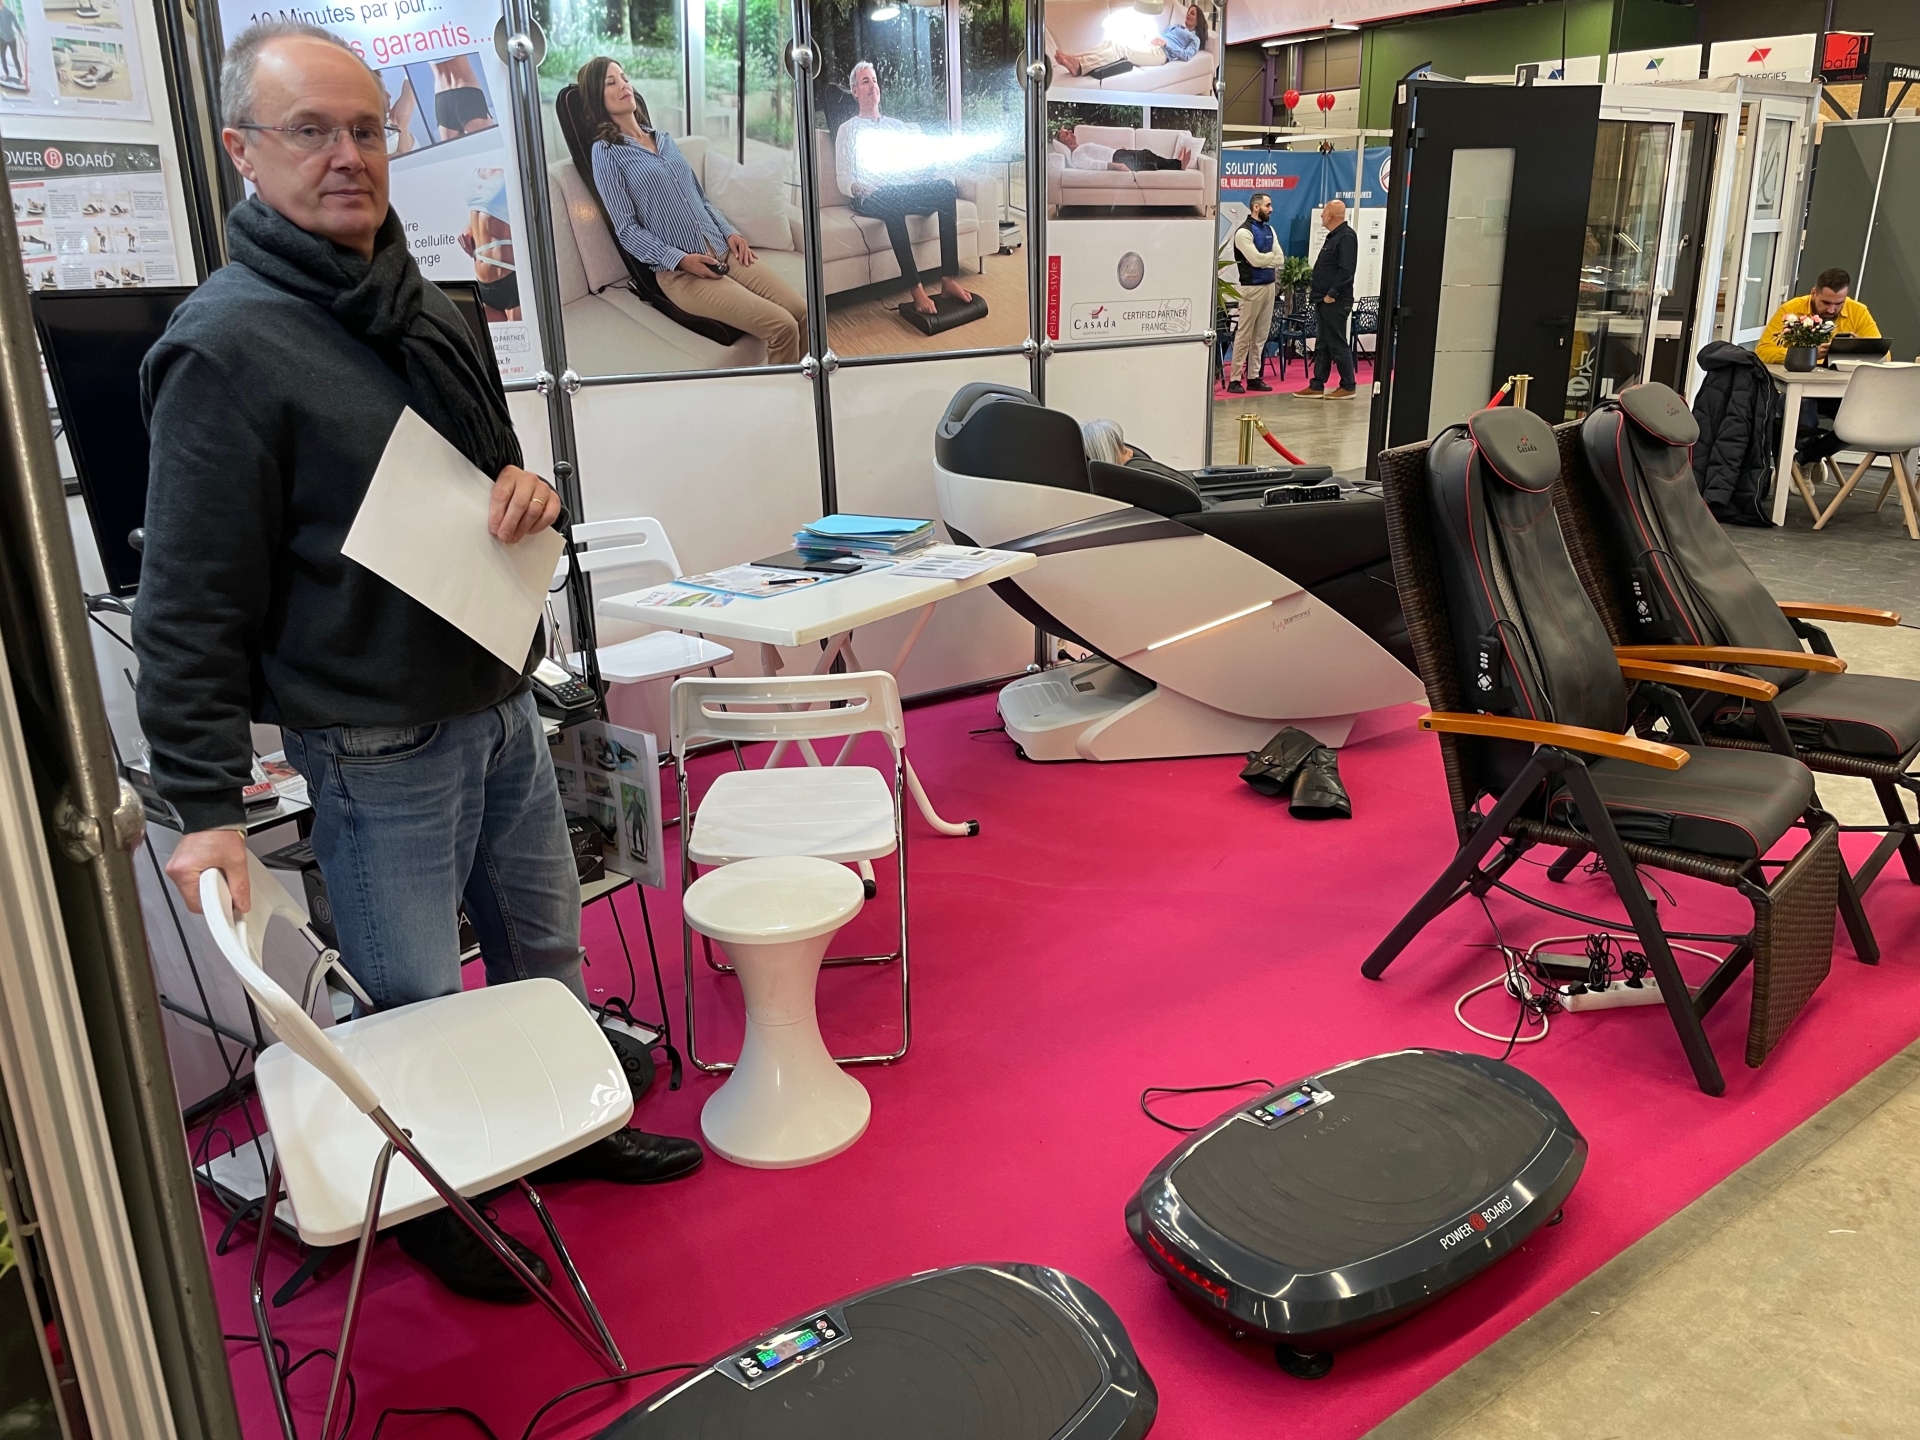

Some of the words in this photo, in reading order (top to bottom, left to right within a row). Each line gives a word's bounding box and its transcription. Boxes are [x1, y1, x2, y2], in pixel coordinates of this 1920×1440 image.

[280, 6, 355, 25] Minutes
[360, 2, 389, 24] par
[372, 20, 492, 64] garantis...
[1847, 36, 1869, 55] 21
[1893, 66, 1920, 80] DEPANN
[4, 150, 42, 166] OWER
[1225, 162, 1278, 175] SOLUTIONS
[405, 221, 419, 232] ire
[415, 235, 456, 249] cellulite
[415, 254, 441, 267] ange
[1049, 262, 1059, 291] style
[1049, 295, 1057, 306] in
[1123, 310, 1157, 321] CERTIFIED
[1157, 308, 1187, 318] PARTNER
[1049, 308, 1057, 336] relax
[1141, 322, 1167, 331] FRANCE
[500, 334, 525, 342] PARTNER
[1439, 1222, 1475, 1250] POWER
